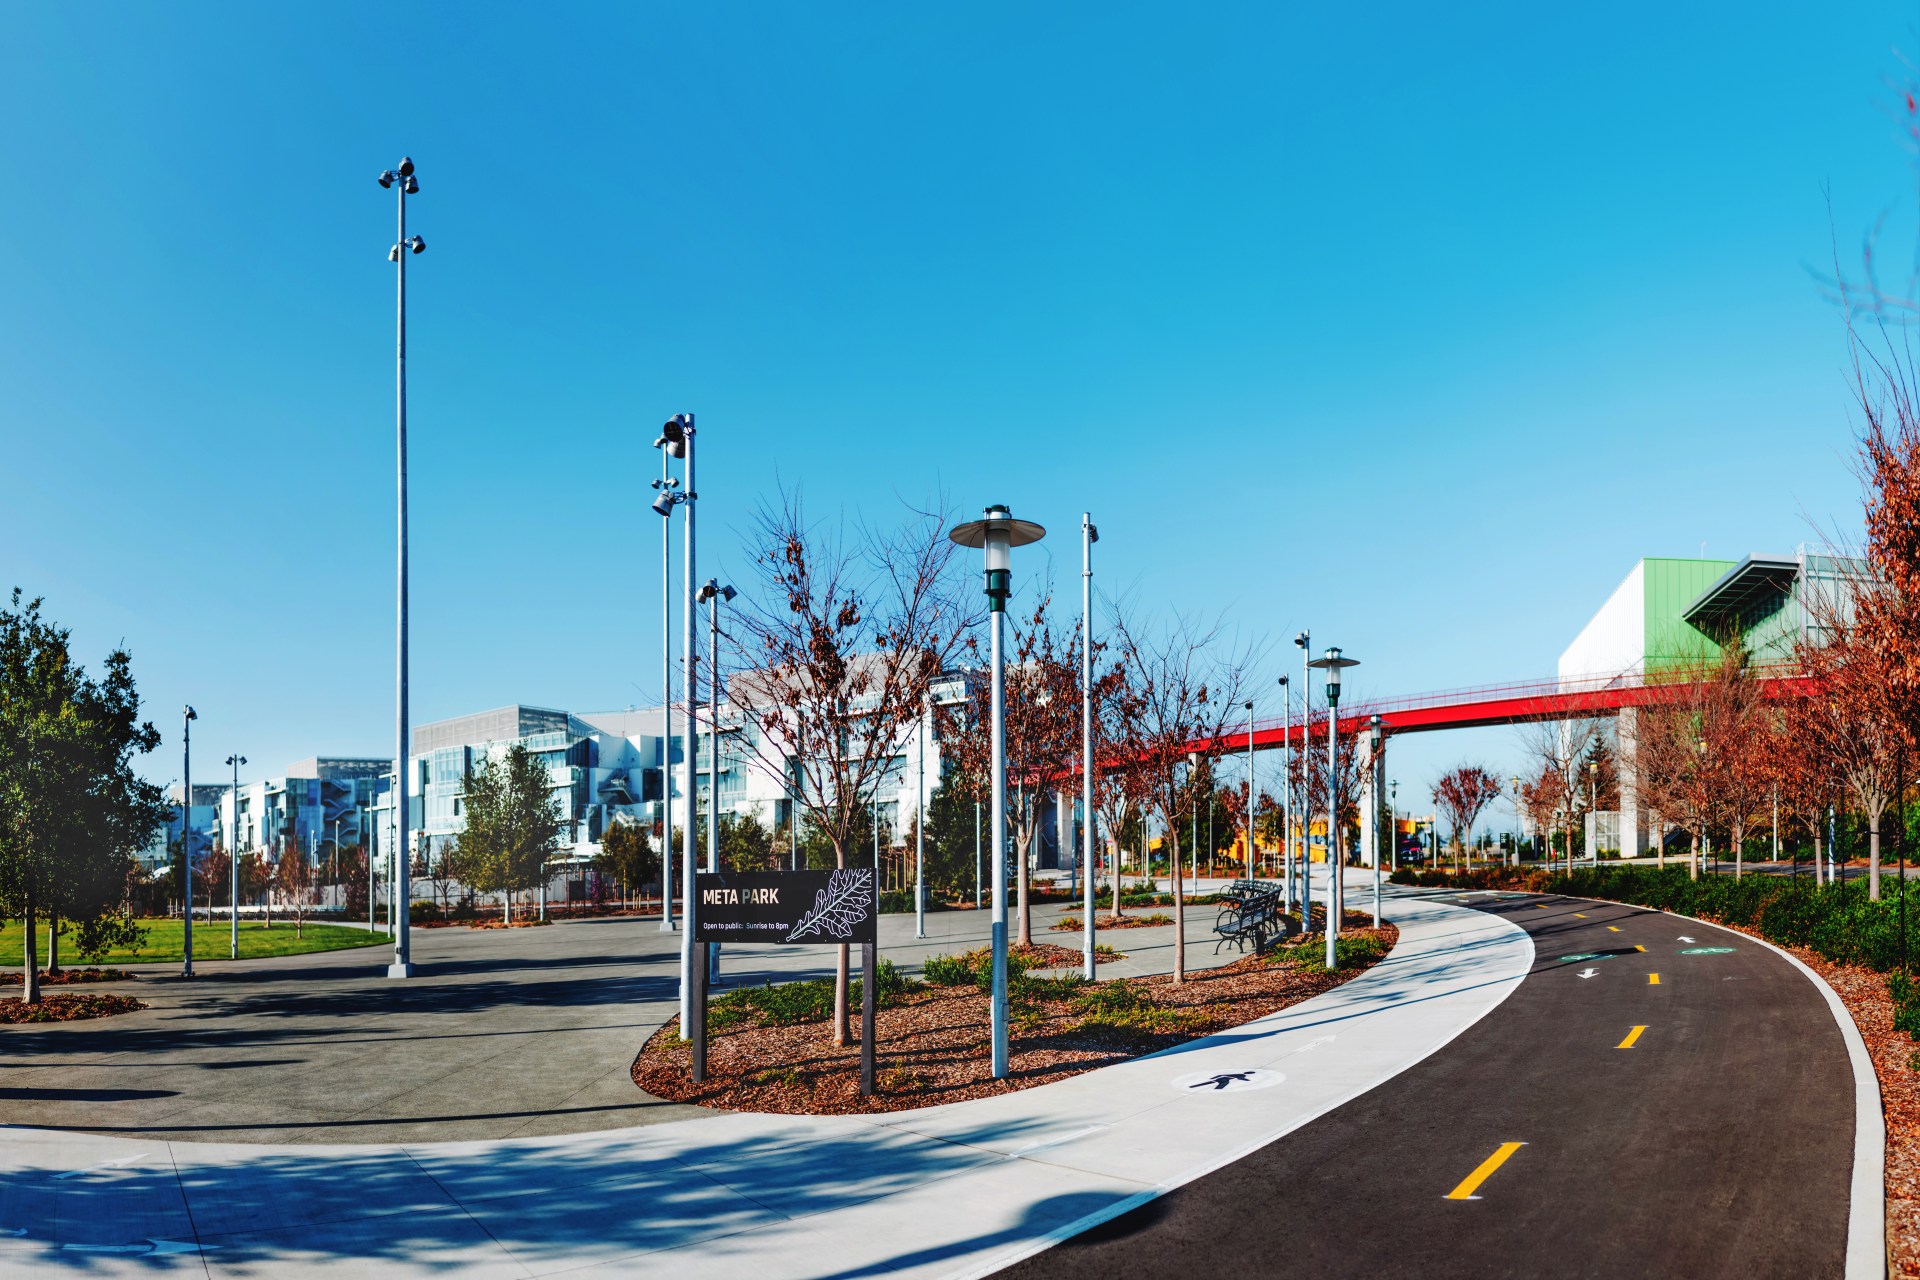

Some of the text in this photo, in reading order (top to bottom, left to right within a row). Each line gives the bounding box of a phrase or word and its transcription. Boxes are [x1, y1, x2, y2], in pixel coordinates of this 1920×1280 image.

[703, 888, 779, 905] META PARK
[703, 922, 718, 931] Open
[718, 922, 725, 930] to
[746, 922, 768, 930] Sunrise
[768, 922, 775, 930] to
[775, 922, 789, 931] 8pm
